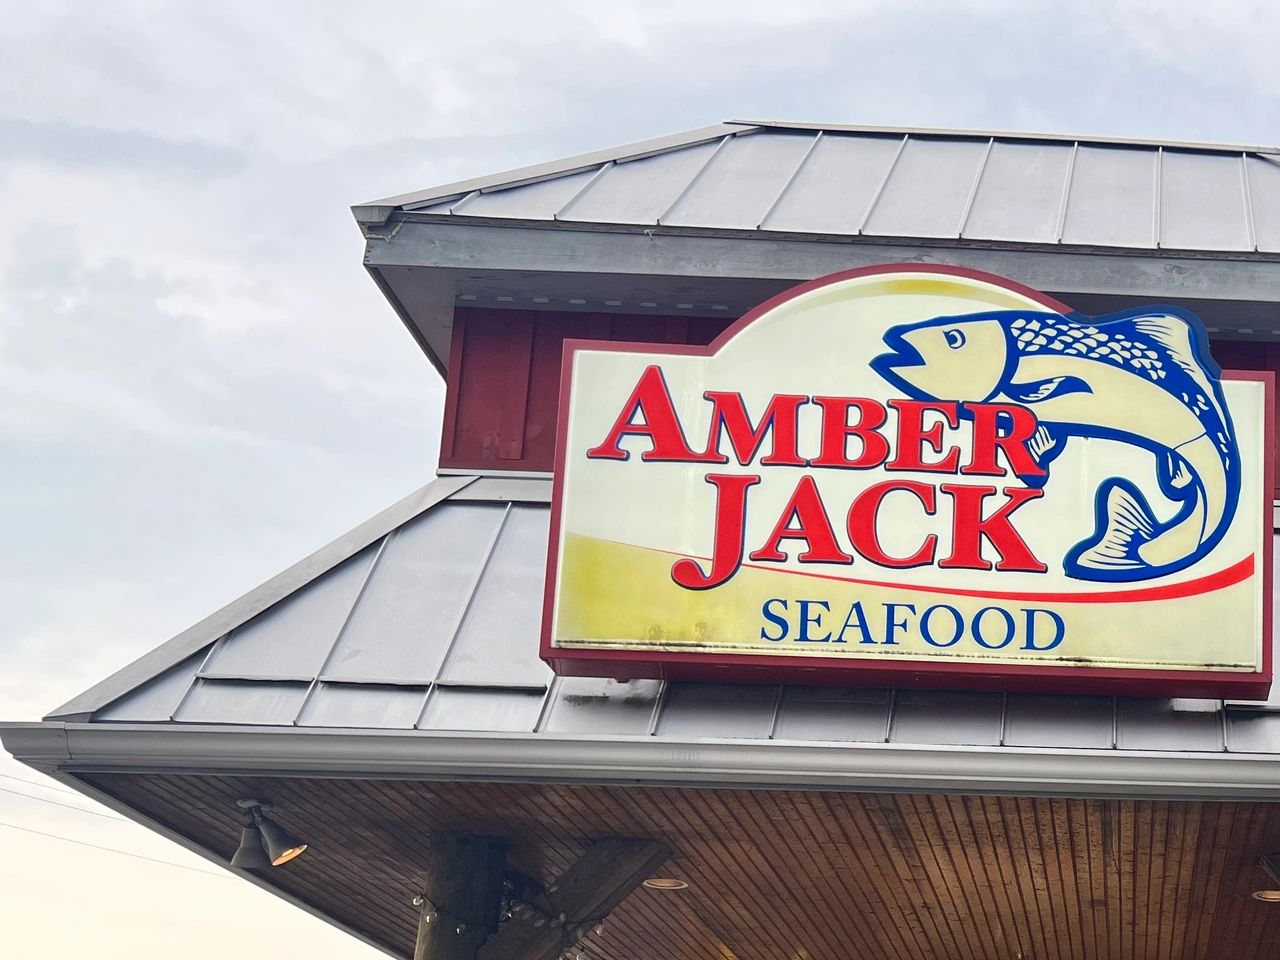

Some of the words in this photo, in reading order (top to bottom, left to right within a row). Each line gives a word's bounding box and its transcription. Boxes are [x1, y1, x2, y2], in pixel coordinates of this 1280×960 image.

[586, 364, 1048, 479] AMBER
[670, 473, 1049, 591] JACK
[759, 598, 1066, 652] SEAFOOD
